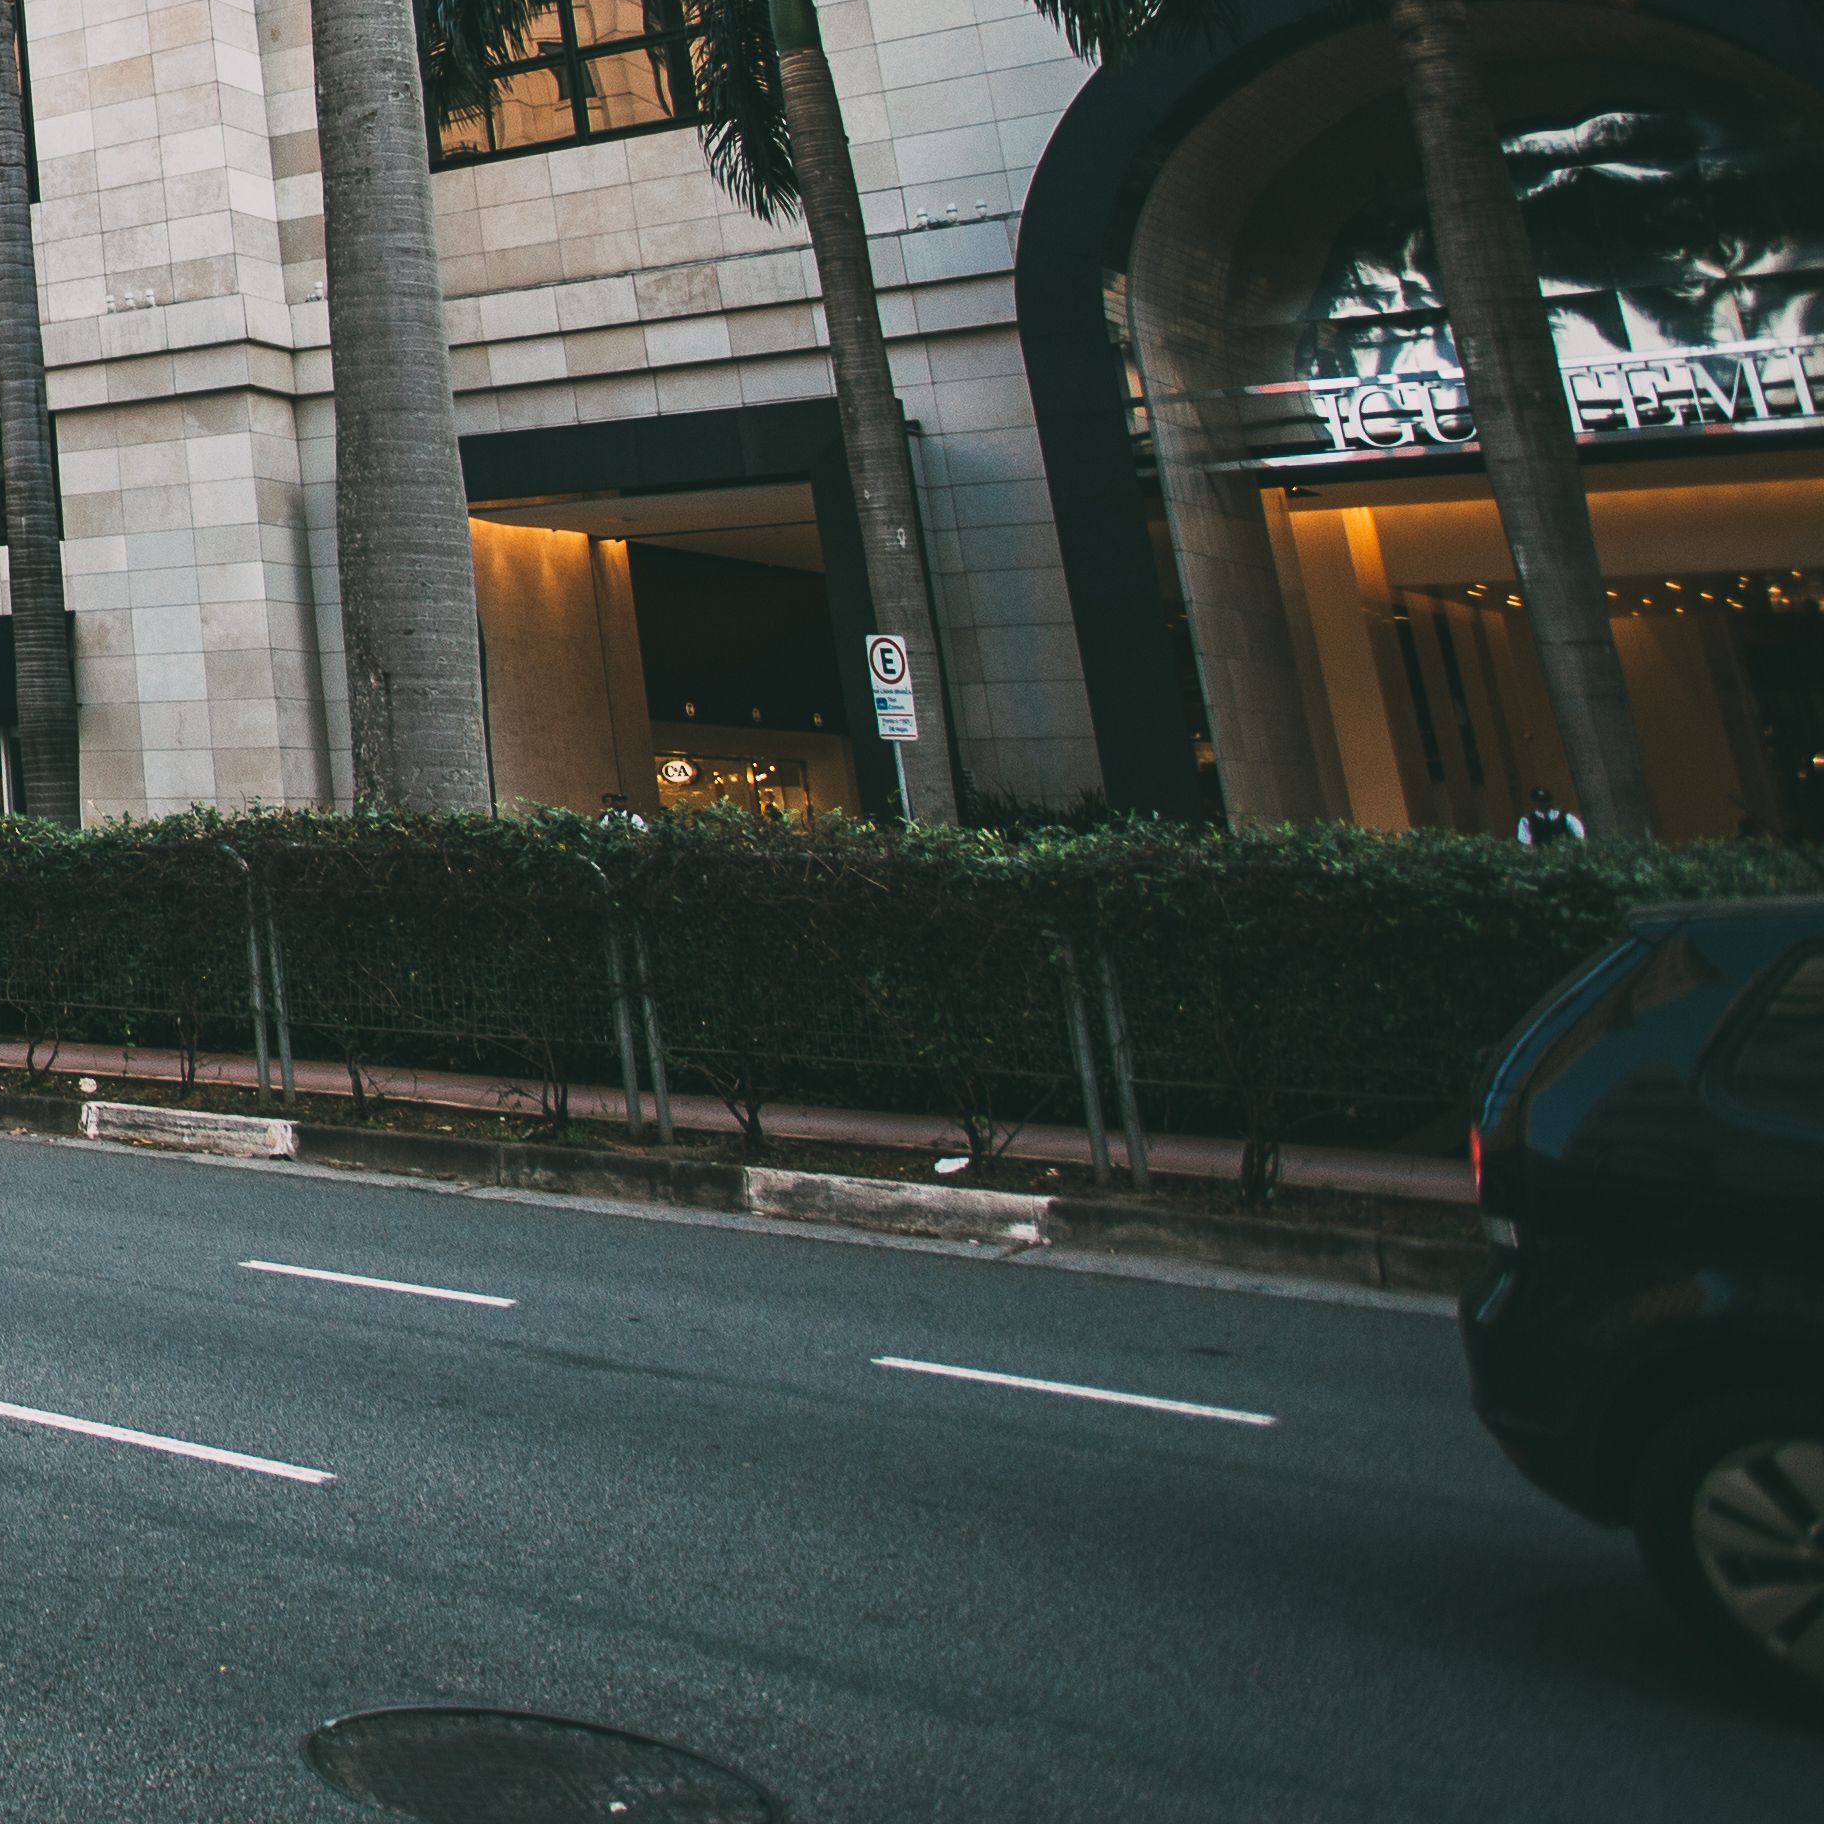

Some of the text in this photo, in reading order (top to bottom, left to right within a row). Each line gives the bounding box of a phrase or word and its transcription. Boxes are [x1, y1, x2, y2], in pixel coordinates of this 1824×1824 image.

[1314, 348, 1823, 452] IGUTEMI
[879, 647, 897, 675] E
[664, 764, 690, 778] C&A
